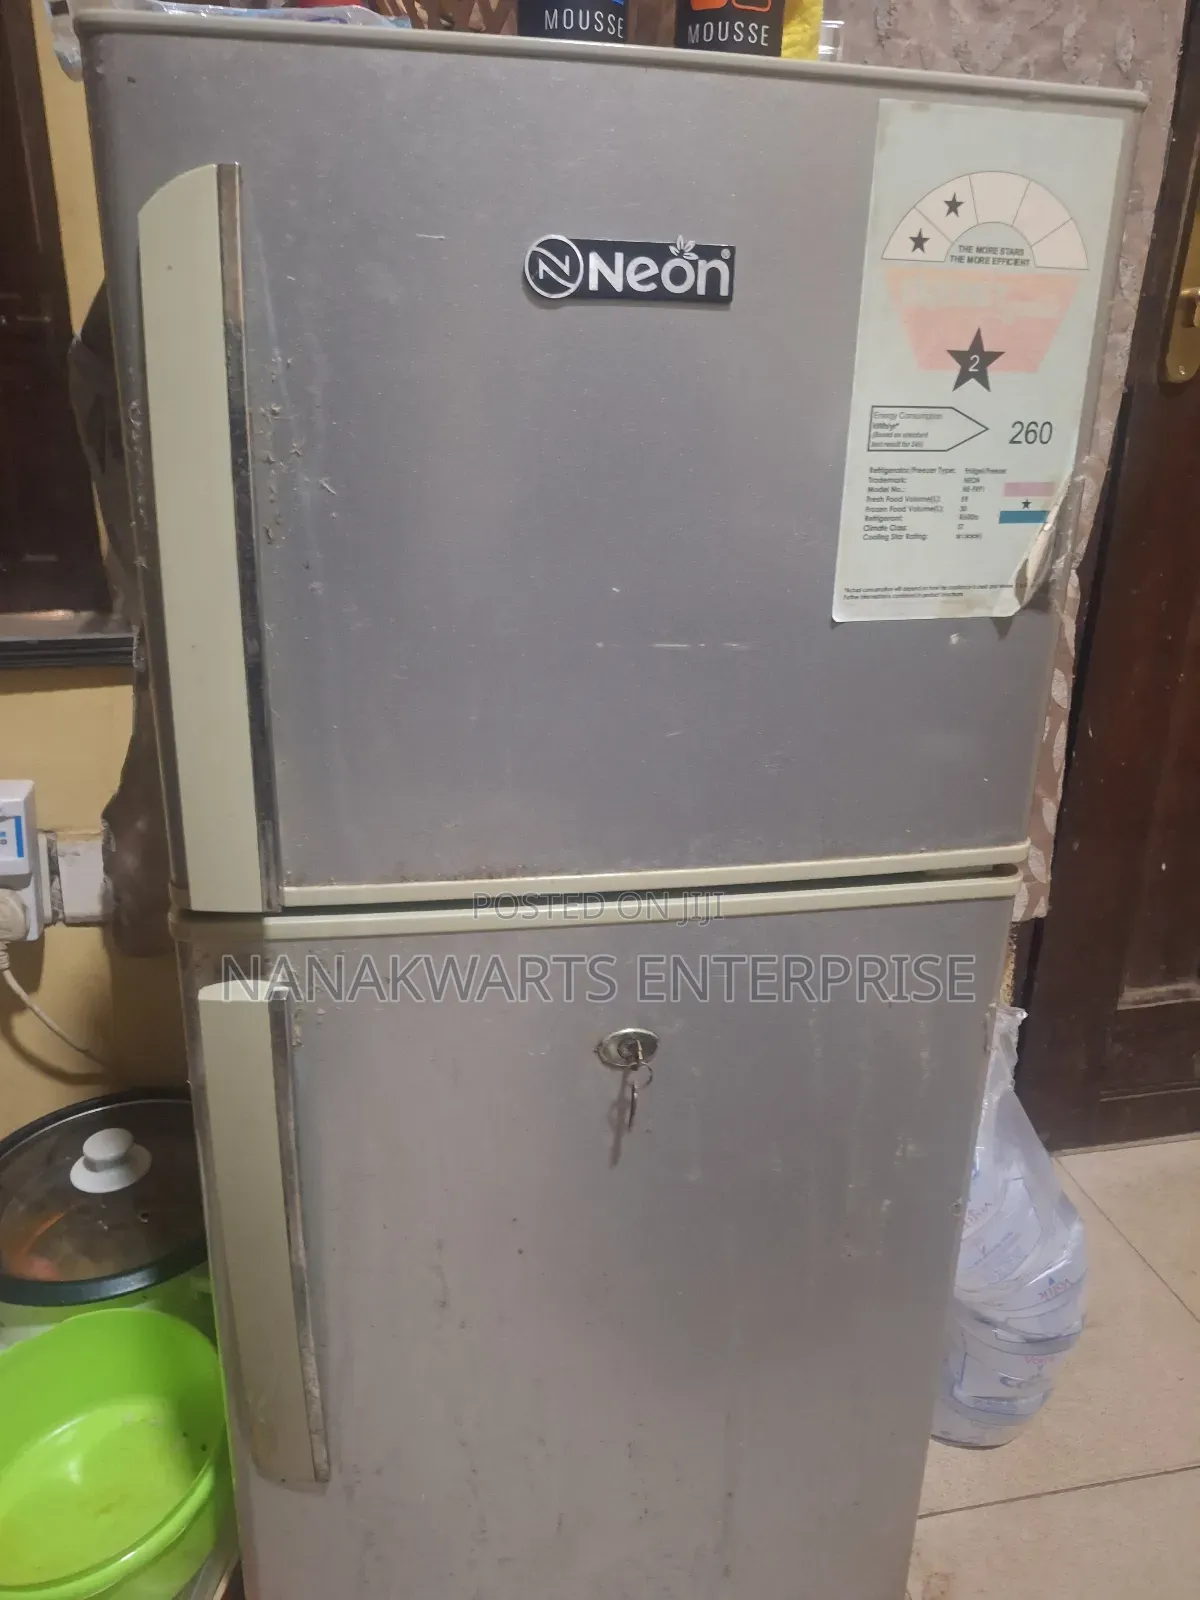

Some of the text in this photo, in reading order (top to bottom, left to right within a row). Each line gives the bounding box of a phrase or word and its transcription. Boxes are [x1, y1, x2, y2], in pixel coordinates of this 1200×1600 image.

[544, 8, 624, 39] MOUSSE
[688, 21, 769, 47] MOUSSE
[958, 245, 1025, 257] THE MORE STARS
[950, 254, 1030, 267] THE MORE EFFICIENT
[968, 355, 981, 372] 2
[873, 411, 943, 421] Energy Consumption
[1009, 420, 1053, 445] 260
[866, 495, 884, 503] Fresh
[886, 495, 903, 503] Food
[889, 505, 907, 513] Food
[863, 524, 888, 532] Climate
[862, 533, 889, 542] Cooling
[891, 533, 904, 541] Star
